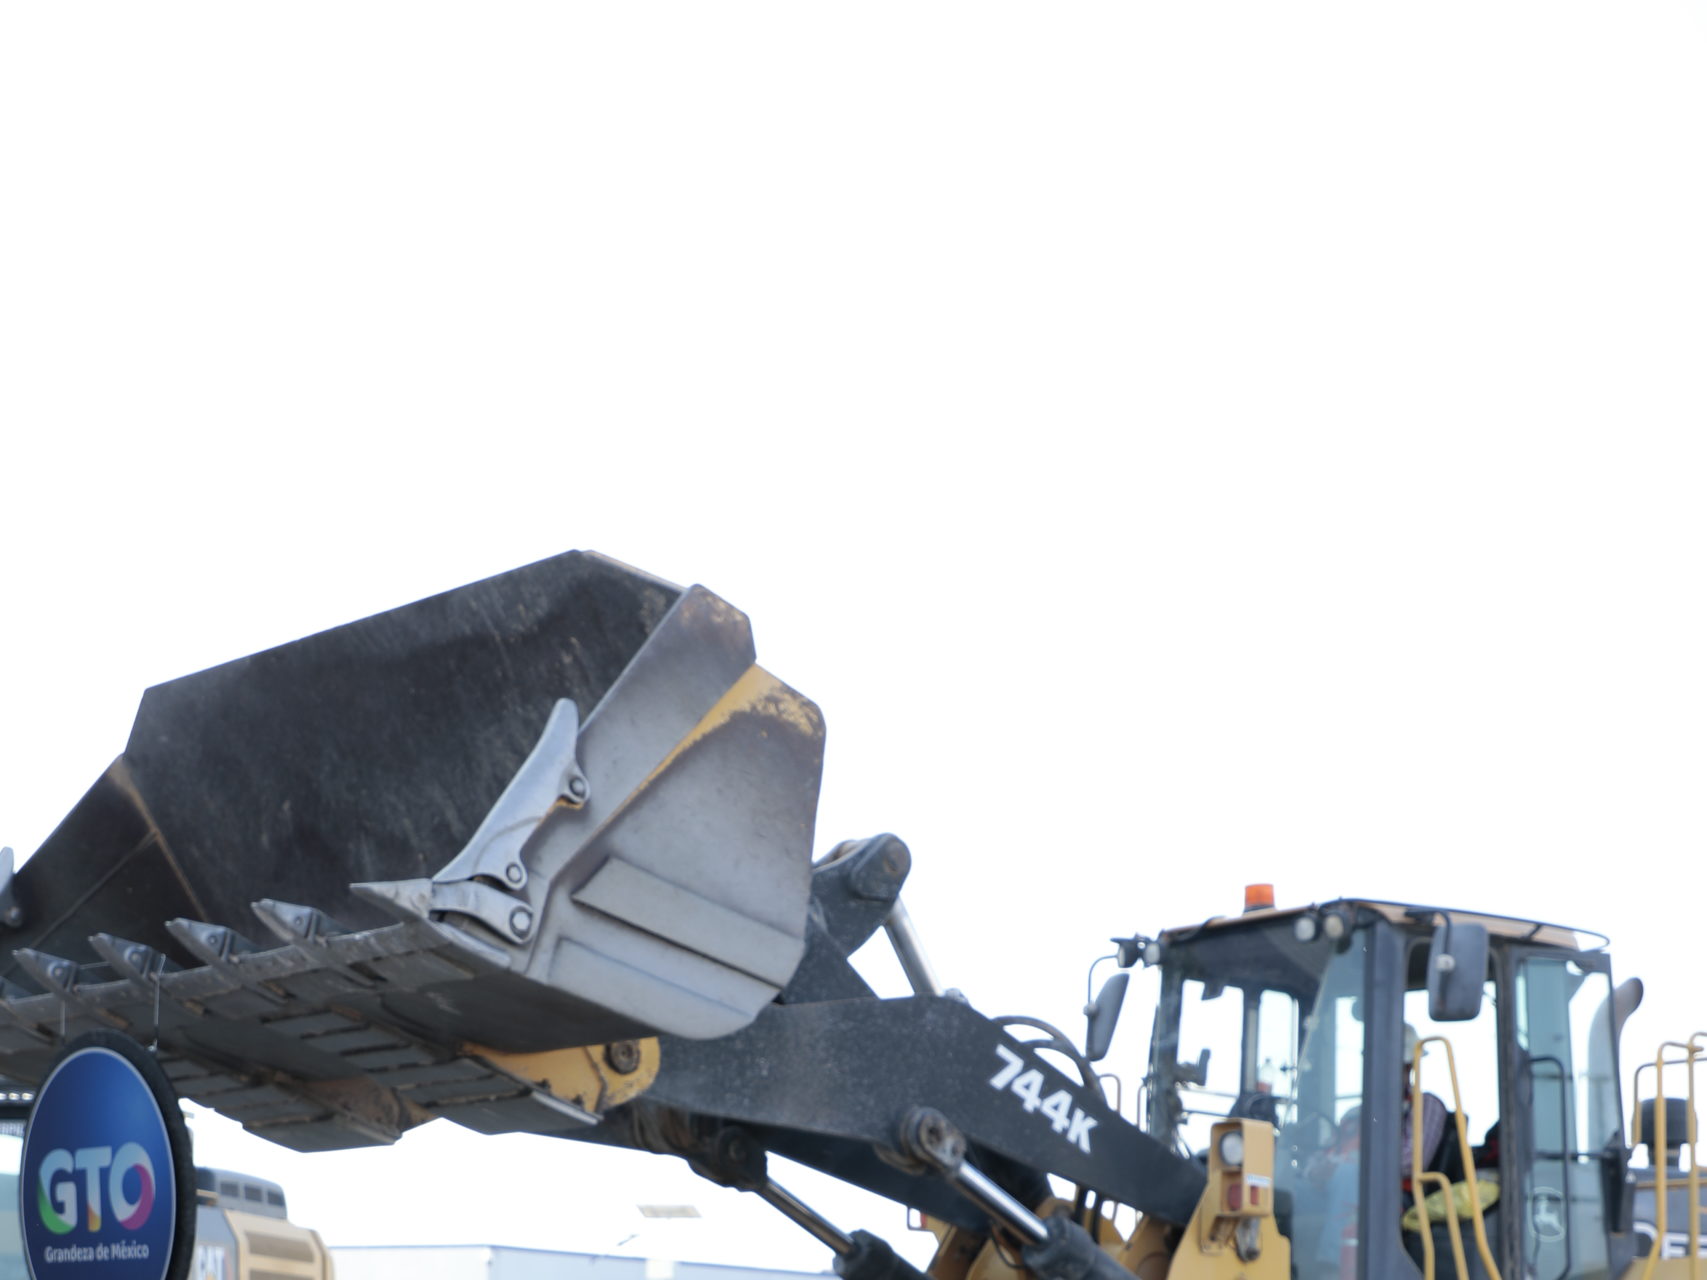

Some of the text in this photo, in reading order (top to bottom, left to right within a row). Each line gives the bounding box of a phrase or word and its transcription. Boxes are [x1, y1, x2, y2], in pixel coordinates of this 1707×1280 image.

[990, 1044, 1098, 1154] 744K
[39, 1142, 155, 1234] GTO
[44, 1240, 149, 1263] Grandeza de México
